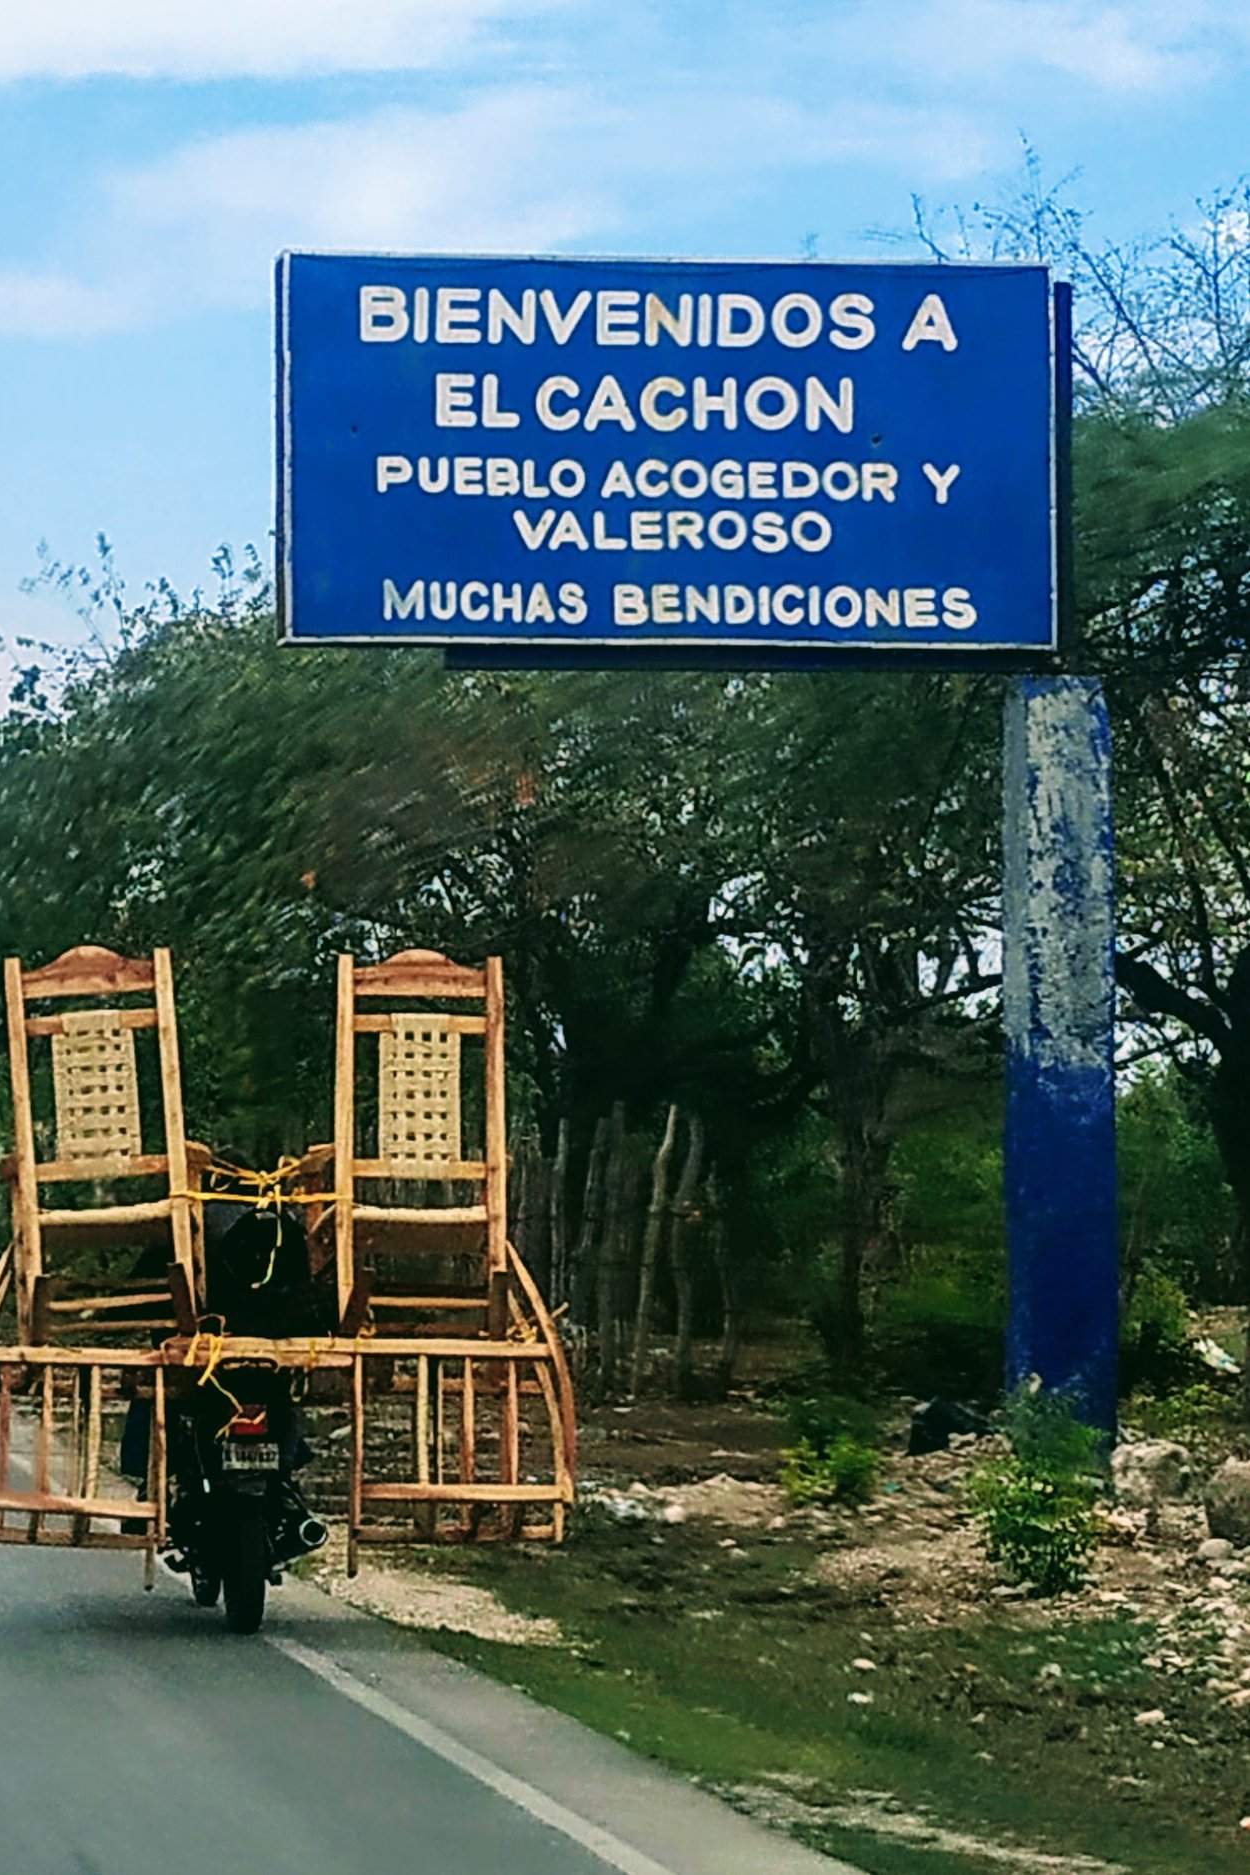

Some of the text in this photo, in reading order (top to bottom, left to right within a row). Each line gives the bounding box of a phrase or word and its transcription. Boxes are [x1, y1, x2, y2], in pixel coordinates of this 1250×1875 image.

[359, 285, 958, 352] BIENVENIDOS A
[435, 373, 854, 434] EL CACHON
[377, 455, 960, 504] PUEBLO ACOGEDOR Y
[513, 509, 832, 554] VALEROSO
[383, 579, 977, 631] MUCHAS BENDICIONES
